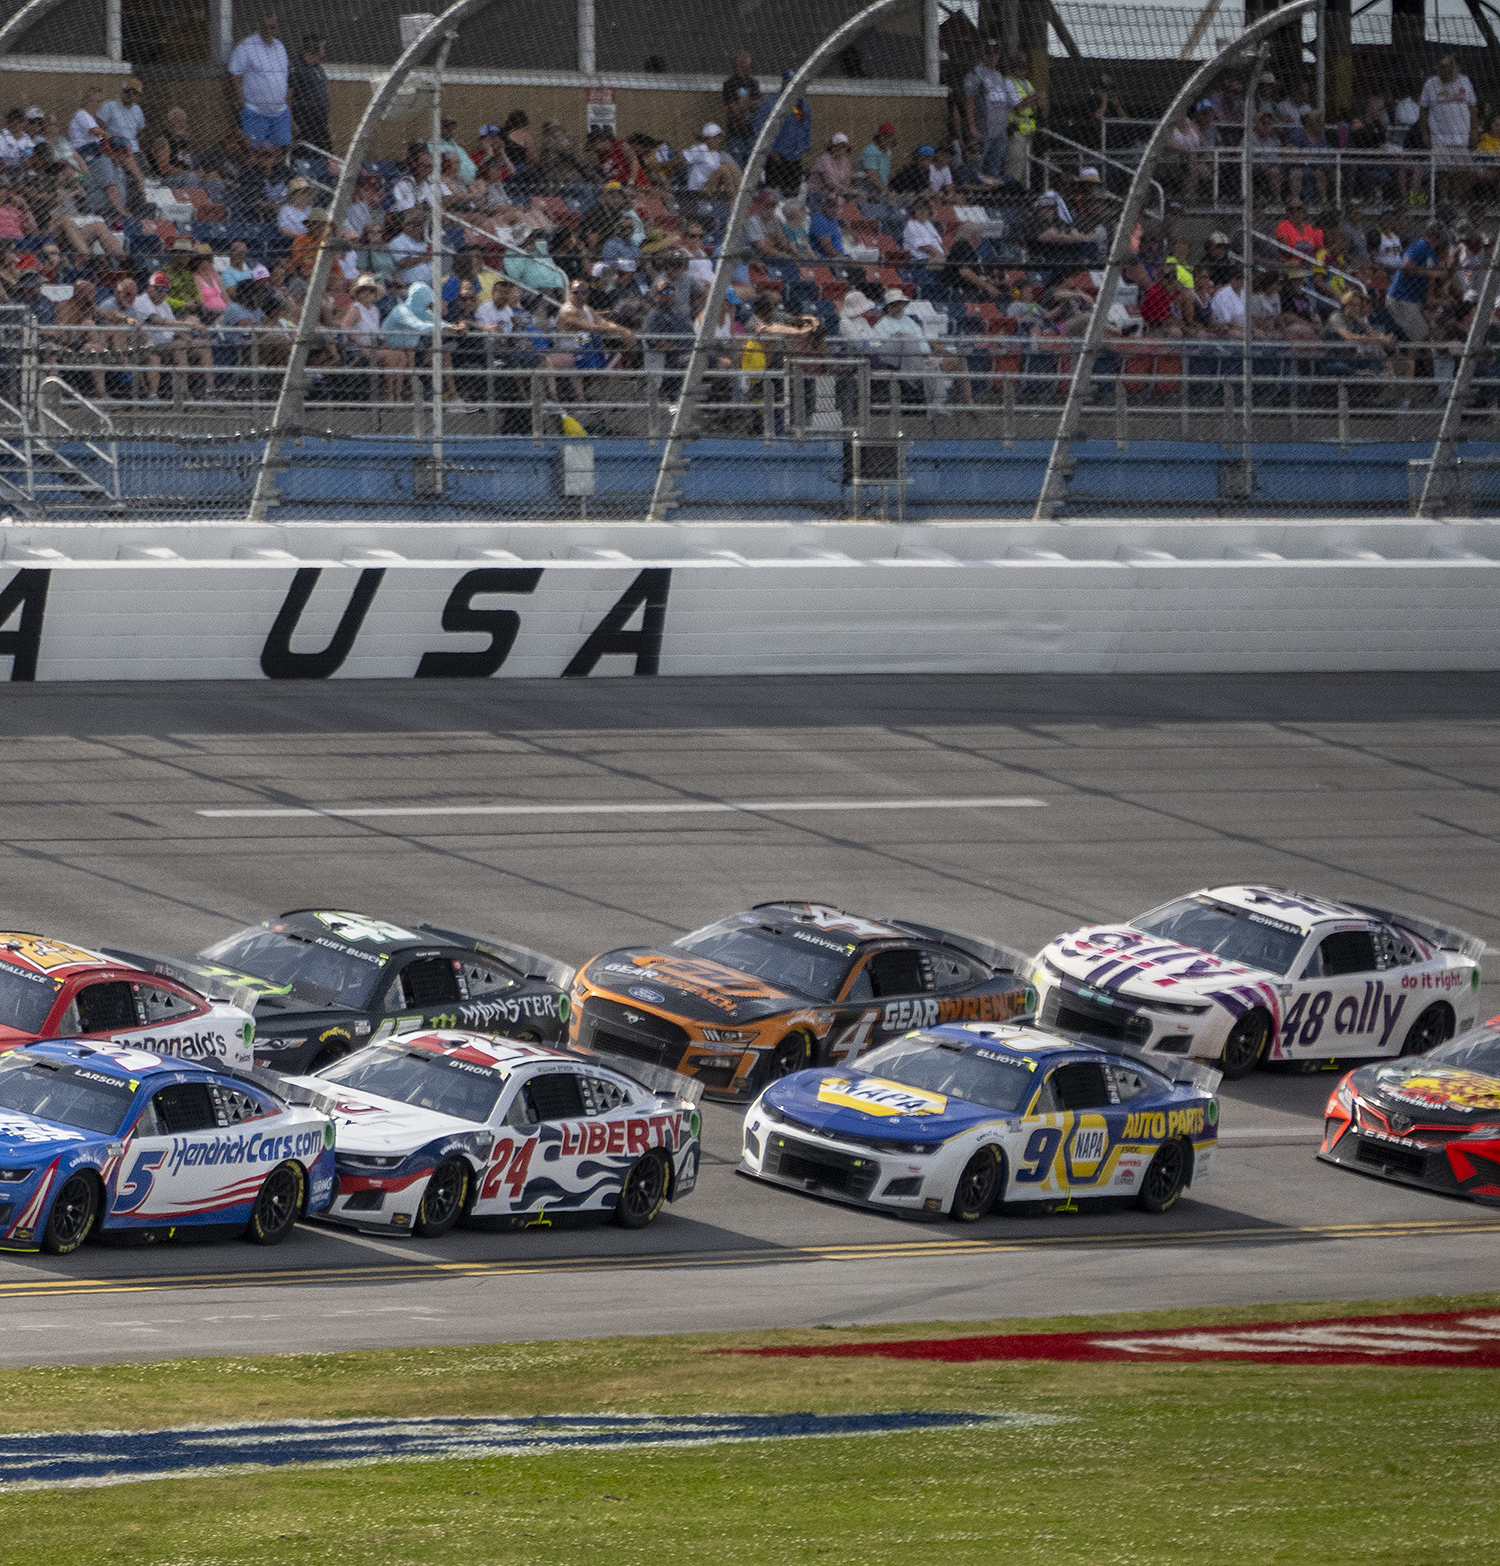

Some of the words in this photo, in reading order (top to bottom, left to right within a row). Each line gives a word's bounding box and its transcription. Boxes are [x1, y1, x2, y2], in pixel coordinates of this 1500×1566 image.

[260, 567, 672, 679] USA
[1249, 913, 1300, 935] BOWMAN
[315, 937, 347, 952] KURT
[794, 931, 846, 953] HARVICK
[1401, 974, 1417, 989] do
[1421, 972, 1432, 989] it
[458, 995, 556, 1028] MONSTER
[1280, 990, 1333, 1048] 48
[1334, 979, 1407, 1047] ally
[831, 1009, 879, 1066] 4
[449, 1060, 492, 1077] BYRON
[977, 1049, 1026, 1068] ELLIOTT
[74, 1069, 125, 1089] LARSON
[840, 1084, 928, 1110] NAPA
[561, 1113, 683, 1157] LIBERTY
[1122, 1112, 1166, 1139] AUTO
[1168, 1108, 1205, 1138] PARTS
[168, 1130, 322, 1176] HendrickCars.com
[1015, 1125, 1064, 1184] 9
[1074, 1131, 1104, 1159] NAPA
[1364, 1130, 1428, 1150] CAMRY
[111, 1149, 167, 1213] 5
[480, 1137, 538, 1199] 24
